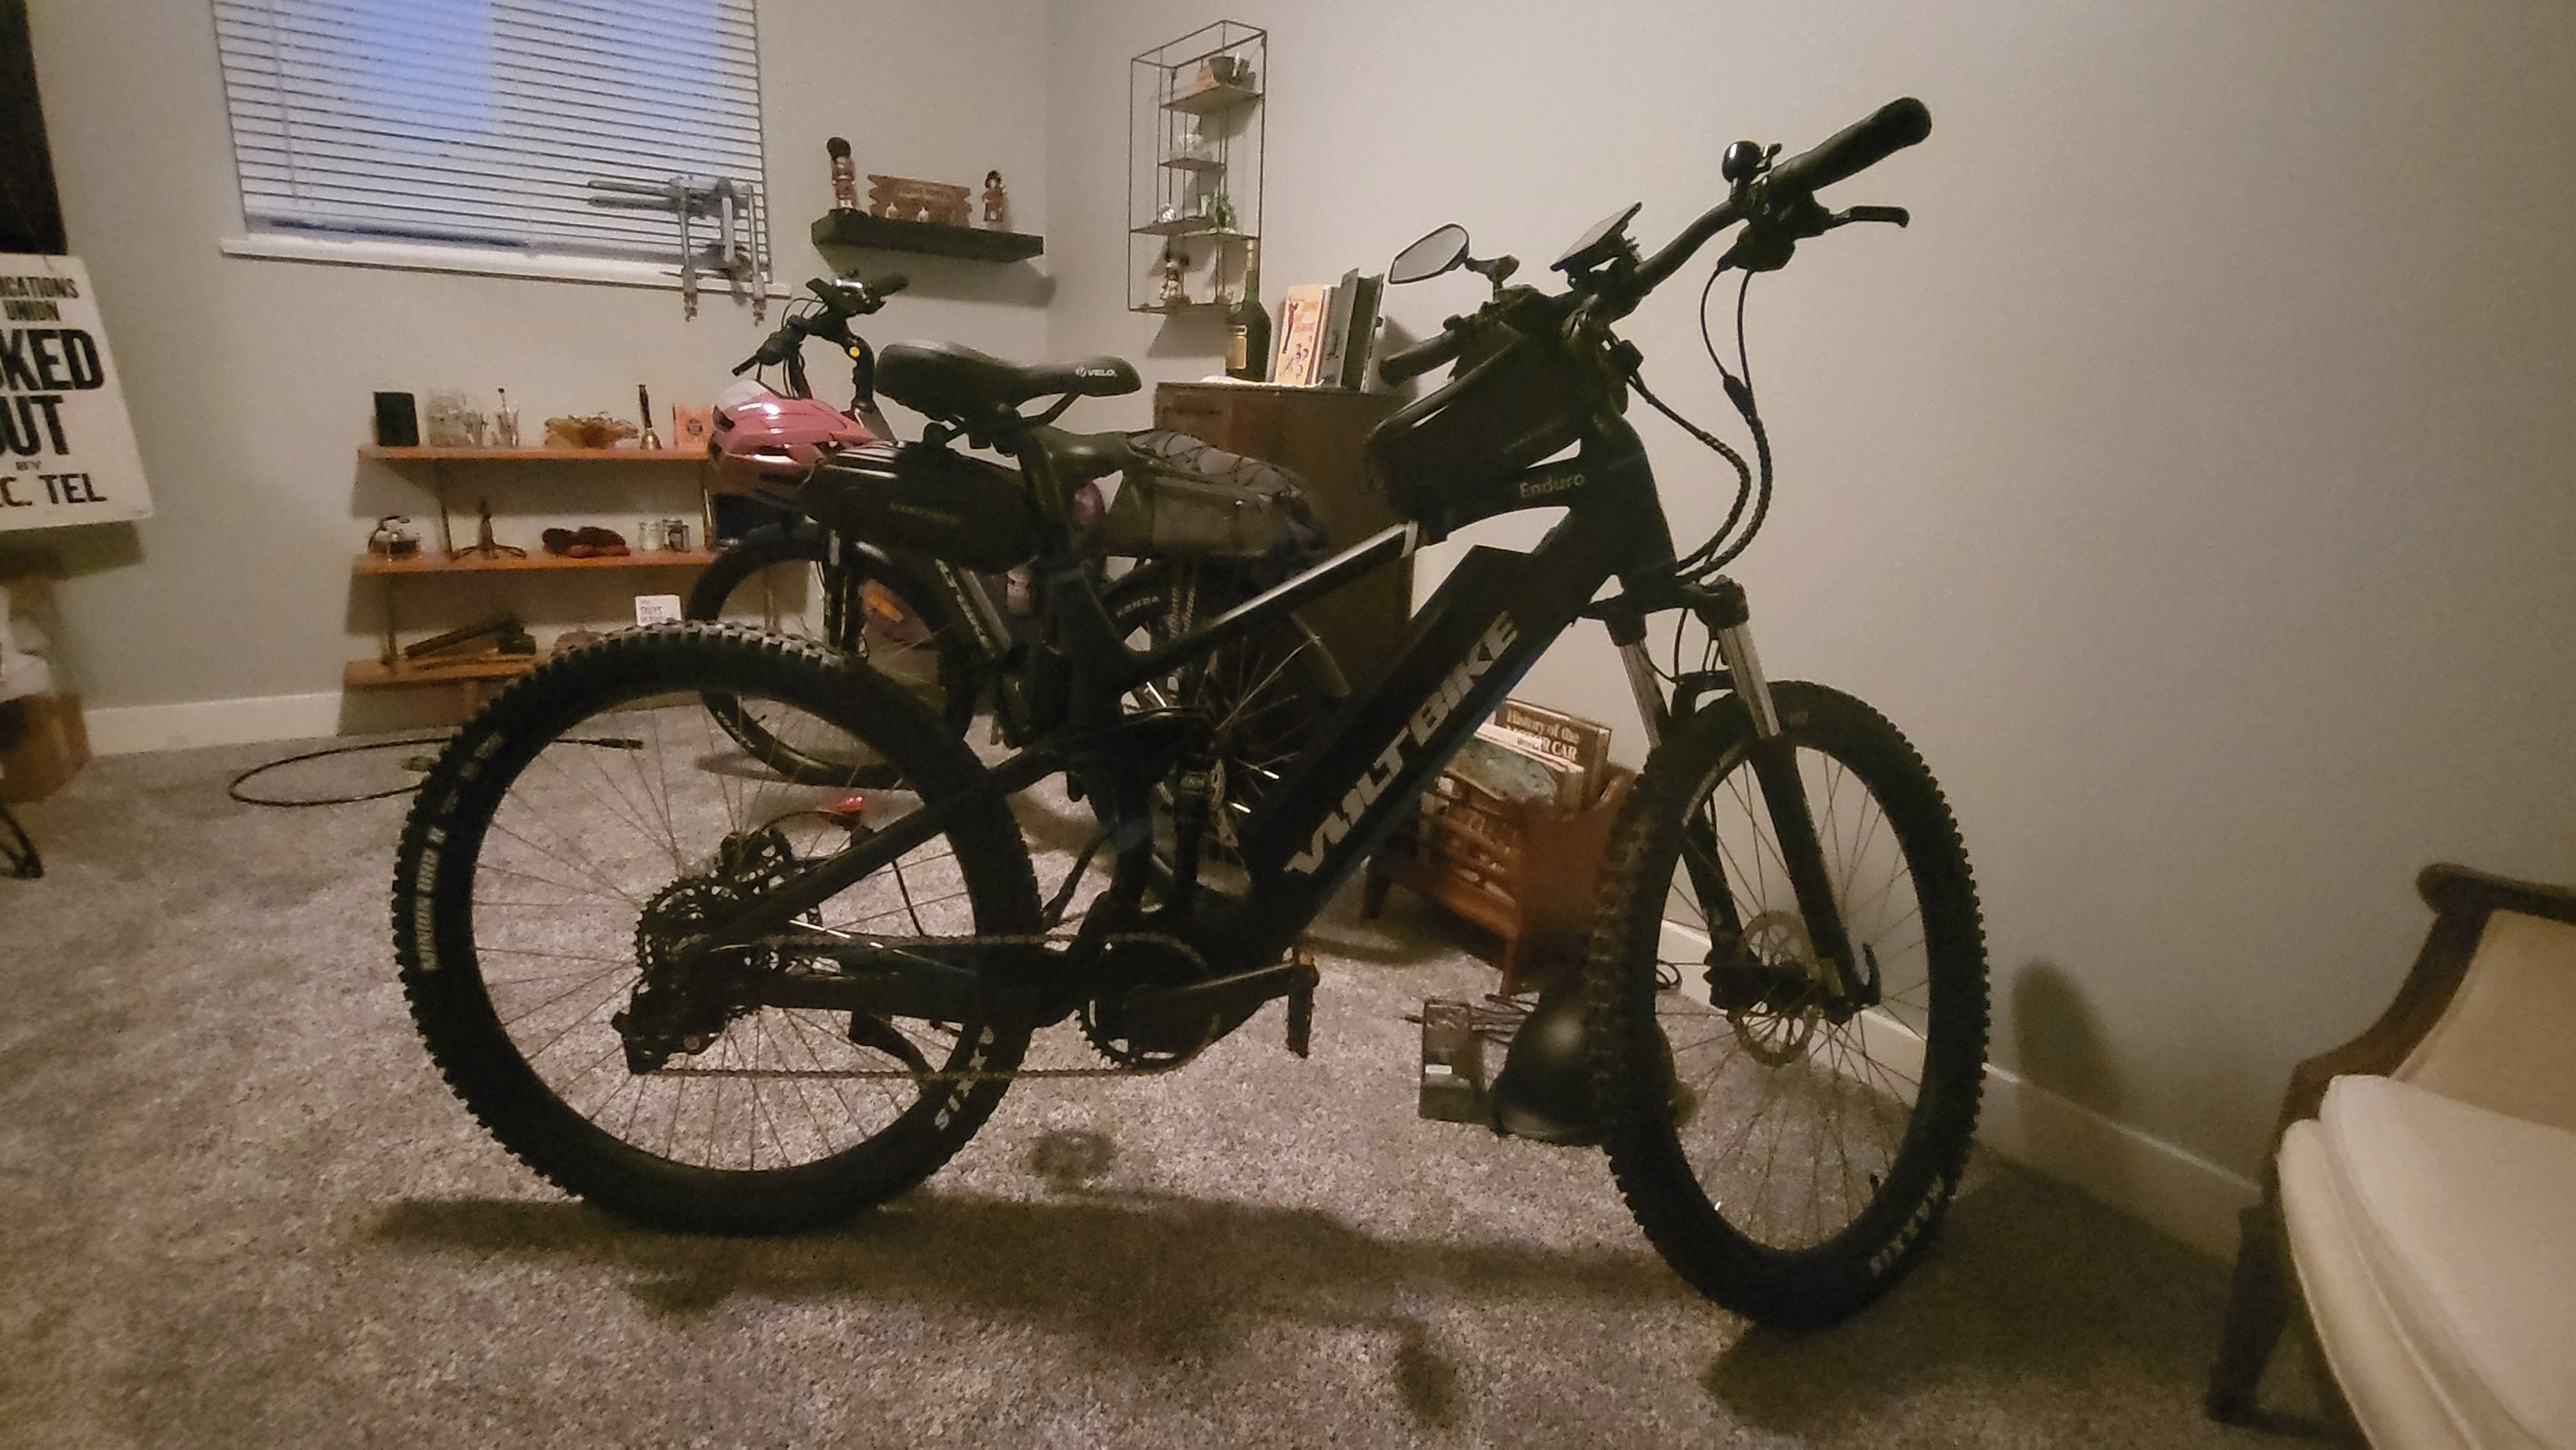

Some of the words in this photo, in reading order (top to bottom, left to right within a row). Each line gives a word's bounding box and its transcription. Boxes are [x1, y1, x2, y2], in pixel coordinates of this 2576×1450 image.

[3, 300, 61, 321] UNION
[0, 328, 104, 391] KED
[1088, 369, 1116, 377] VELO
[0, 393, 70, 457] UT
[38, 473, 108, 504] TEL
[1519, 473, 1585, 498] Enduro
[1506, 708, 1544, 735] History
[1547, 722, 1560, 737] of
[1561, 725, 1580, 744] the
[1551, 741, 1577, 762] CAR
[934, 1025, 995, 1131] AXXIS
